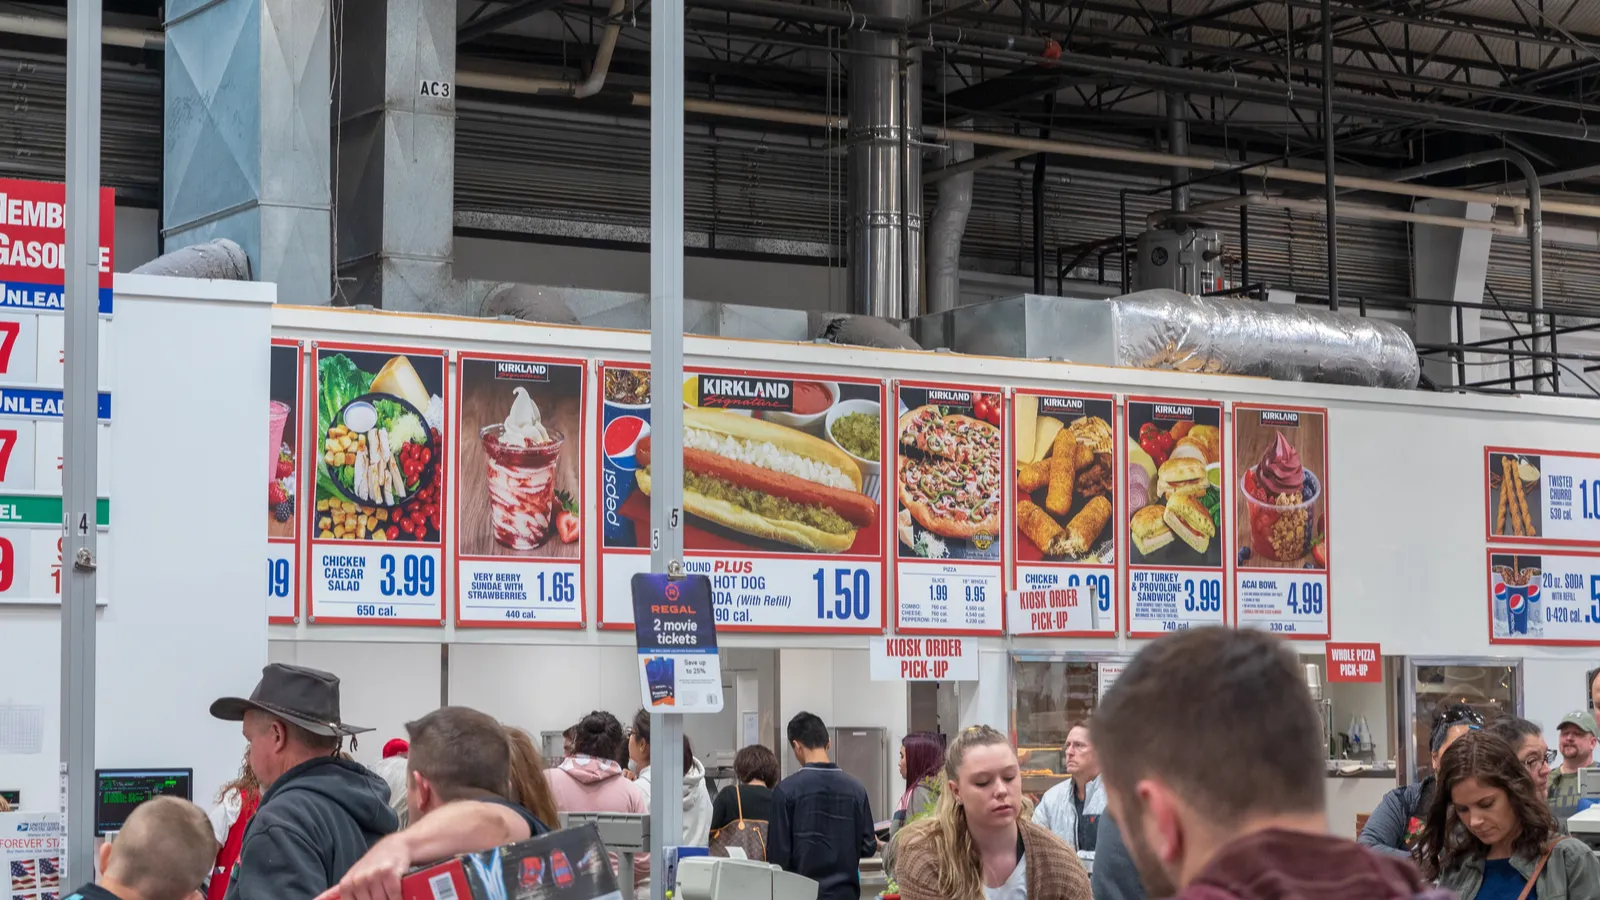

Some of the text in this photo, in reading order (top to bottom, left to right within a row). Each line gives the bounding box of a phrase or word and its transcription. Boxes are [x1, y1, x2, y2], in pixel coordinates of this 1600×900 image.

[420, 80, 450, 98] AC3
[0, 192, 66, 229] EMB
[498, 363, 546, 375] KIRKLAND
[703, 378, 790, 399] KIRKLAND
[703, 394, 789, 409] Signature
[929, 390, 970, 401] KIRKLAND
[1043, 398, 1083, 408] KIRKLAND
[1155, 405, 1192, 415] KIRKLAND
[1262, 411, 1298, 421] KIRKLAND
[1548, 475, 1573, 489] TWISTED
[603, 468, 620, 527] pepsi
[1550, 488, 1572, 501] CHURRO
[670, 508, 679, 528] 5
[1550, 508, 1573, 520] 530 cal.
[79, 513, 88, 534] 4
[653, 530, 659, 549] 5
[322, 555, 366, 567] CHICKEN
[714, 561, 753, 574] PLUS
[324, 567, 364, 580] CAESAR
[380, 554, 435, 597] 3.99
[473, 572, 521, 582] VERY BERRY
[1025, 573, 1058, 585] CHICKEN
[1134, 572, 1179, 583] HOT TURKEY
[328, 580, 360, 591] SALAD
[471, 582, 523, 591] SUNDAE WITH
[537, 572, 575, 602] 1.65
[714, 575, 766, 590] HOT DOG
[1131, 582, 1182, 592] & PROVOLONE
[1241, 580, 1278, 589] ACAI BOWL
[1542, 573, 1553, 588] 20
[1564, 573, 1584, 589] SODA
[468, 591, 527, 600] STRAWBERRIES
[812, 568, 870, 620] 1.50
[929, 584, 948, 601] 1.99
[965, 585, 986, 602] 9.95
[1020, 591, 1047, 610] KIOSK
[1049, 588, 1078, 608] ORDER
[1137, 592, 1176, 602] SANDWICH
[1184, 579, 1221, 612] 3.99
[1287, 582, 1322, 614] 4.99
[1551, 592, 1576, 601] WITH REFILL
[736, 595, 761, 608] (With
[763, 595, 792, 609] Refill)
[357, 605, 397, 616] 650 cal.
[505, 610, 536, 619] 440 cal.
[651, 604, 697, 614] REGAL
[713, 608, 753, 622] 90 cal.
[1546, 607, 1583, 623] 0-420 cal.
[653, 619, 698, 631] 2 movie
[1031, 611, 1068, 630] PICK-UP
[1162, 621, 1176, 631] 740
[1270, 622, 1297, 632] 330 cal.
[657, 632, 697, 644] tickets
[886, 638, 962, 657] KIOSK ORDER
[1331, 648, 1376, 662] WHOLE PIZZA
[901, 660, 949, 678] PICK-UP
[1340, 663, 1369, 677] PICK-UP
